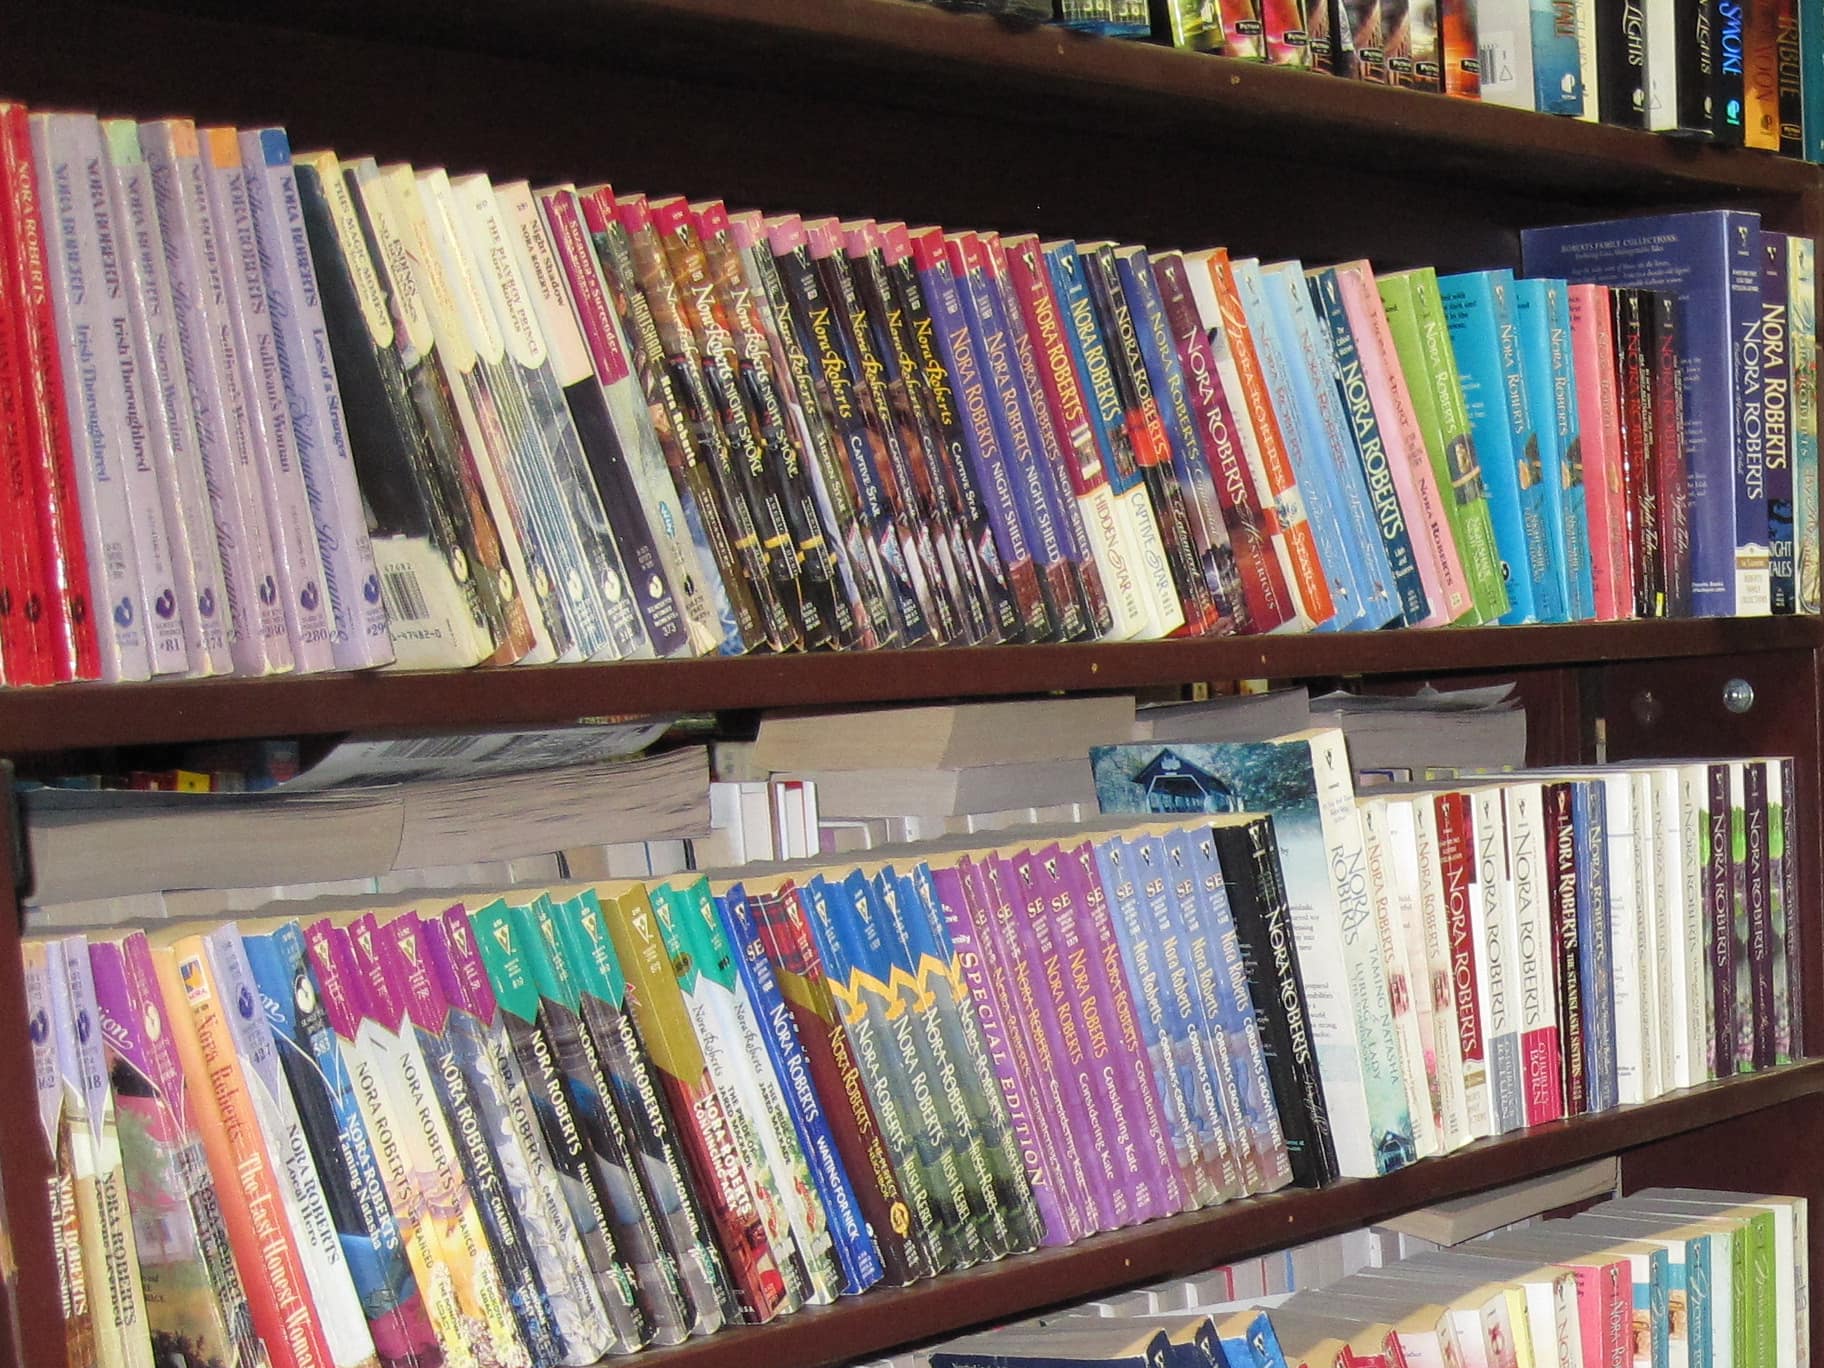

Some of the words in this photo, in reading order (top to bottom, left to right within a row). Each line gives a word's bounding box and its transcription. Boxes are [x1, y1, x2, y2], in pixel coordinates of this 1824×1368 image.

[1719, 0, 1743, 75] SMOKE
[87, 157, 105, 208] NORA
[96, 209, 120, 299] ROBERTS
[486, 218, 502, 244] THE
[517, 303, 540, 356] PRINCE
[531, 218, 549, 253] Night
[542, 257, 566, 308] Shadow
[569, 219, 599, 286] Suzanna's
[590, 285, 619, 355] Surrender
[112, 316, 129, 354] Irish
[631, 291, 666, 362] NIGHTSHADE
[1033, 295, 1059, 349] NORA
[1048, 343, 1085, 421] ROBERTS
[1741, 320, 1759, 395] NORA
[1761, 302, 1786, 369] NORA
[119, 354, 150, 473] Thoroughbred
[1116, 306, 1140, 366] NORA
[1133, 367, 1169, 456] ROBERTS
[1181, 325, 1211, 406] NORA
[1206, 409, 1248, 506] ROBERTS
[1764, 377, 1787, 470] ROBERTS
[949, 326, 971, 385] NORA
[965, 382, 998, 459] ROBERTS
[991, 461, 1009, 511] NIGHT
[1004, 507, 1026, 561] SHIELD
[1071, 296, 1097, 349] NORA
[1087, 345, 1123, 422] ROBERTS
[1129, 491, 1155, 554] CAPTIVE
[1342, 361, 1371, 438] NORA
[1362, 436, 1403, 540] ROBERTS
[1743, 401, 1764, 501] ROBERTS
[1345, 845, 1369, 926] NORA
[1515, 833, 1532, 917] NORA
[1713, 813, 1726, 878] NORA
[1051, 891, 1072, 913] SE
[1330, 845, 1360, 947] ROBERTS
[1447, 865, 1468, 951] NORA
[1715, 882, 1728, 969] ROBERTS
[1068, 948, 1091, 1000] NORA
[1264, 904, 1294, 983] NORA
[1279, 979, 1311, 1066] ROBERTS
[1456, 951, 1477, 1053] ROBERTS
[1521, 919, 1541, 1027] ROBERTS
[199, 1013, 222, 1073] Nora
[959, 951, 1002, 1065] SPECIAL
[999, 1074, 1046, 1188] EDITION
[1079, 994, 1109, 1060] ROBERTS
[212, 1064, 245, 1145] Roberts
[769, 1002, 795, 1058] NORA
[787, 1053, 820, 1124] ROBERTS
[816, 1135, 840, 1184] WAITING
[834, 1182, 848, 1208] FOR
[841, 1206, 859, 1242] NICK
[893, 1015, 916, 1077] NORA
[911, 1072, 946, 1147] ROBERTS
[939, 1147, 959, 1187] IRISH
[950, 1181, 969, 1225] REBEL
[1102, 1066, 1130, 1146] Considering
[239, 1151, 268, 1197] The
[1123, 1140, 1138, 1174] Kate
[250, 1188, 275, 1236] Last
[491, 1197, 513, 1246] CHARMED
[264, 1234, 300, 1311] Honest
